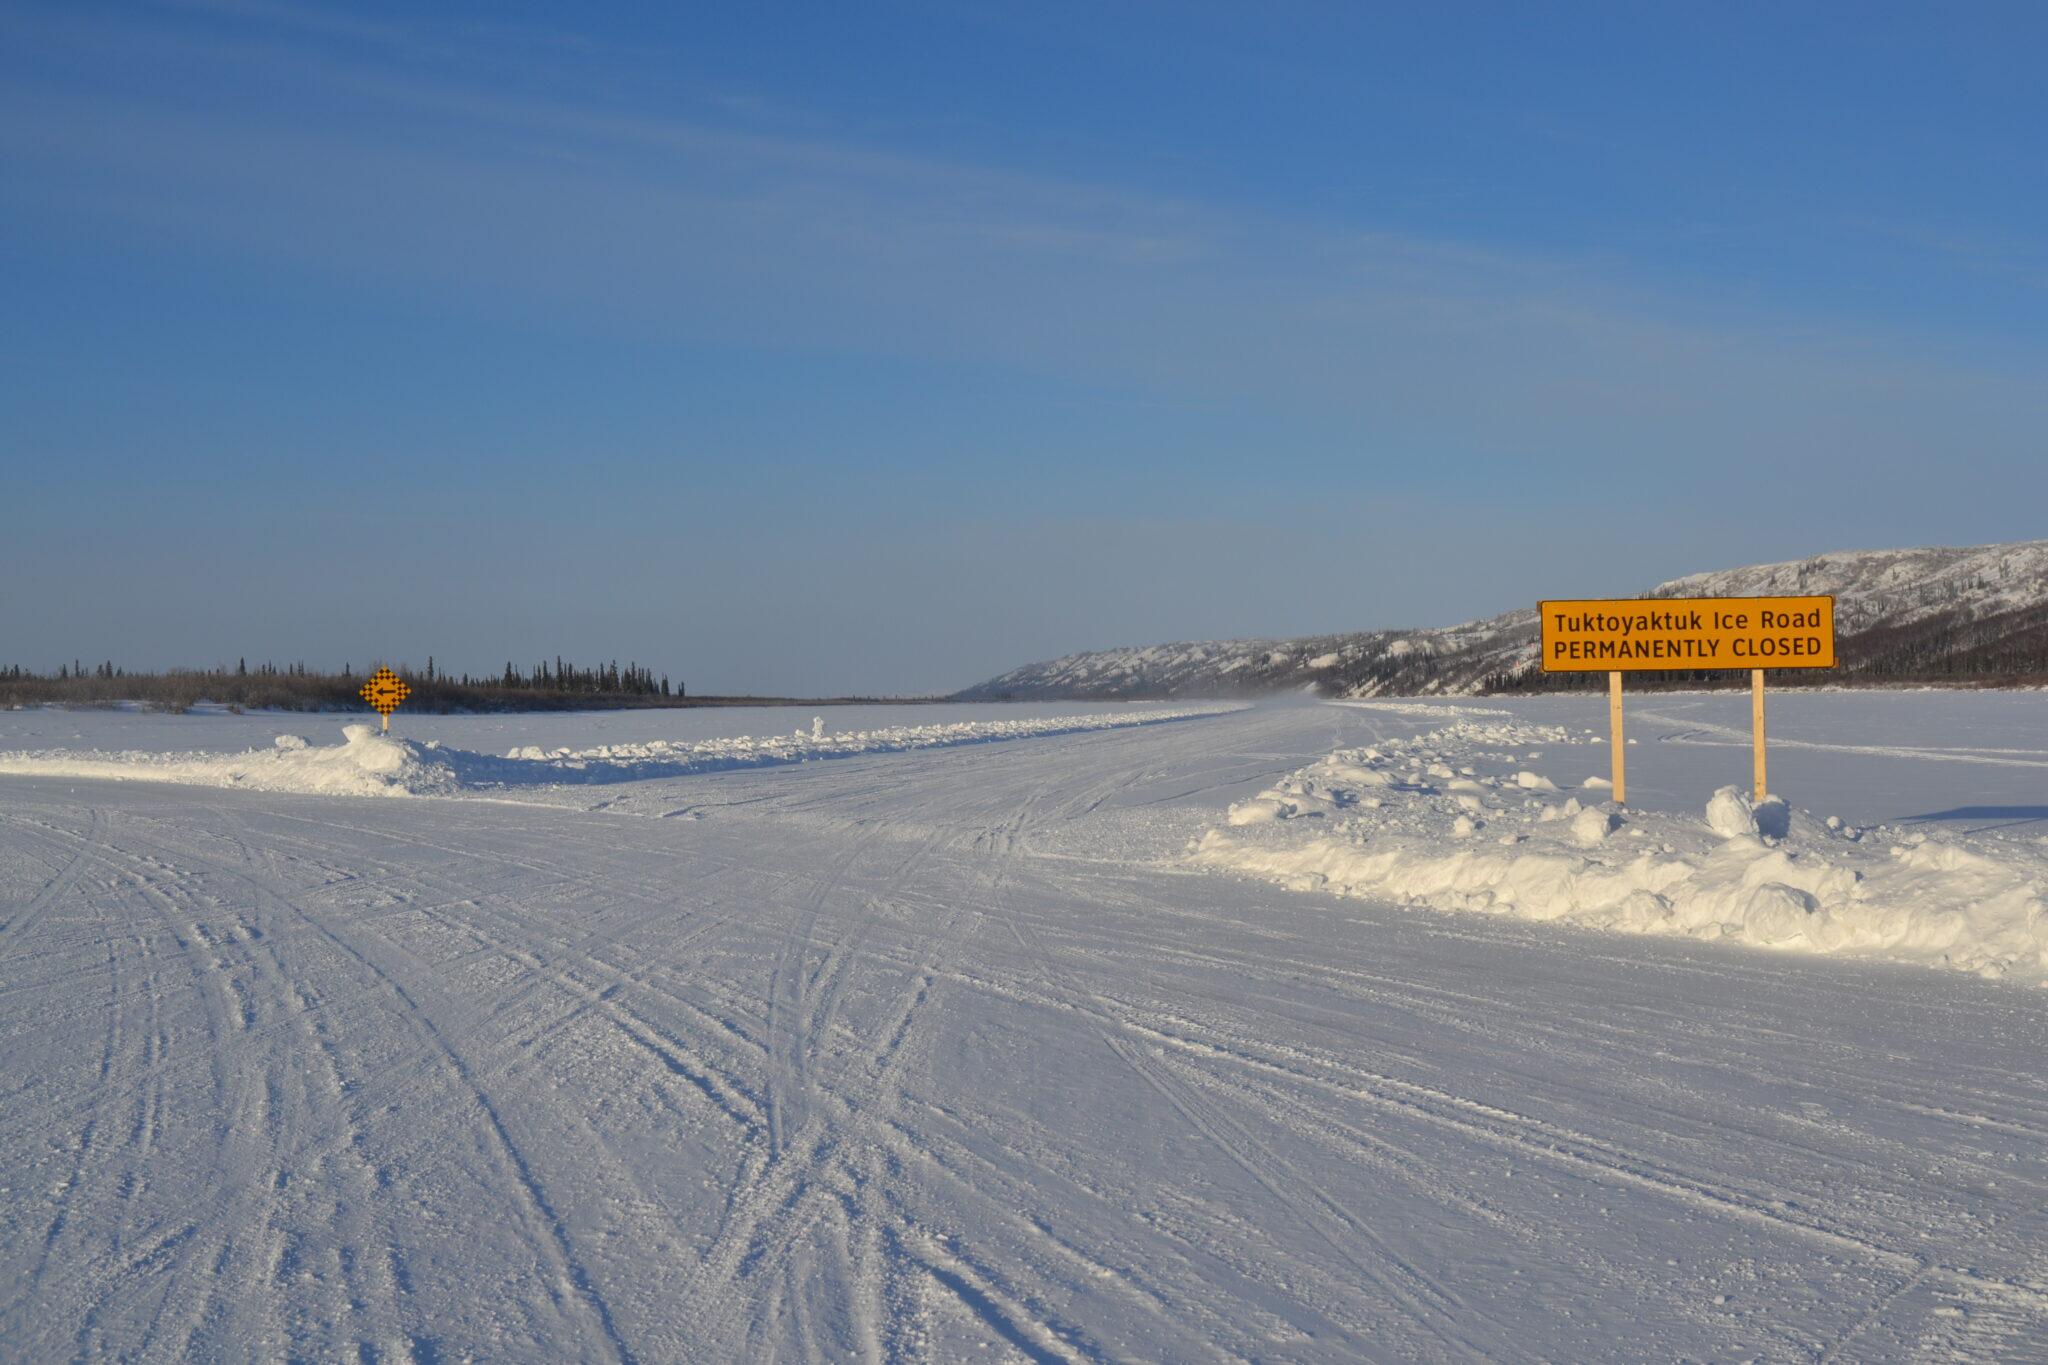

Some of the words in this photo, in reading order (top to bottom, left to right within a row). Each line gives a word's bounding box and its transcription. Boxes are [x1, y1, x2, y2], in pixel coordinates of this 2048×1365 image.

[1554, 611, 1702, 635] Tuktoyaktuk
[1714, 612, 1748, 629] Ice
[1761, 609, 1820, 629] Road
[1554, 639, 1720, 659] PERMANENTLY
[1732, 637, 1821, 657] CLOSED
